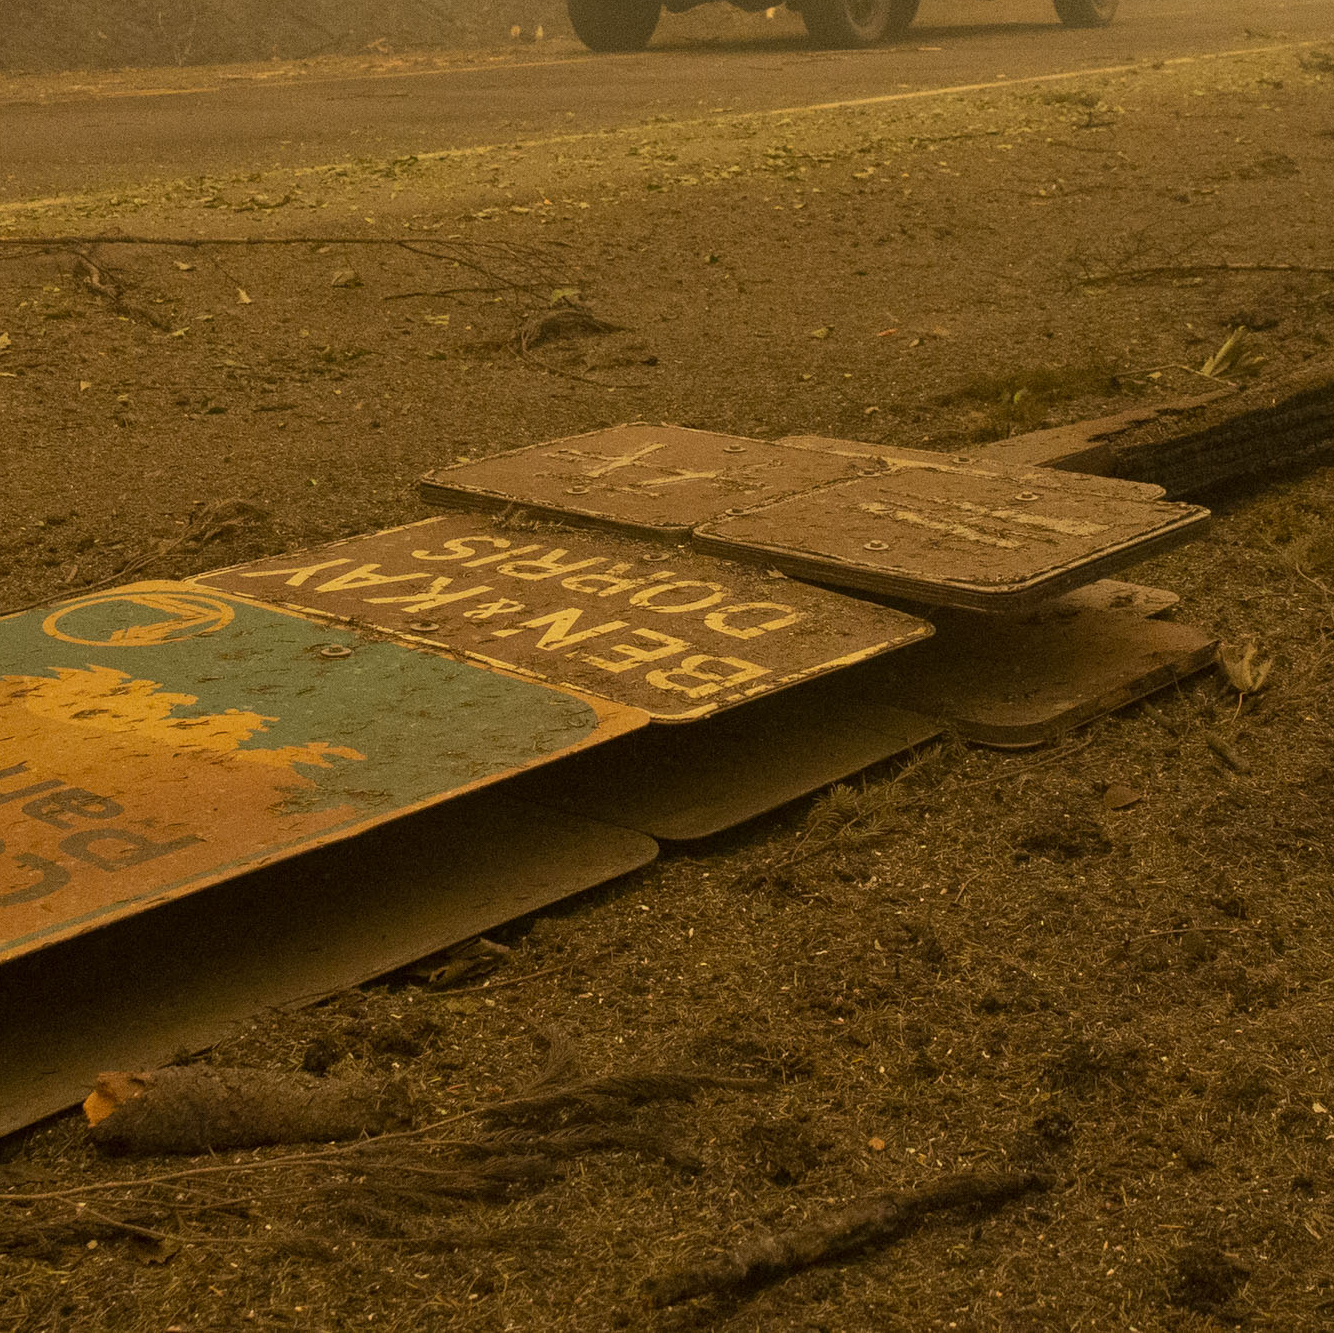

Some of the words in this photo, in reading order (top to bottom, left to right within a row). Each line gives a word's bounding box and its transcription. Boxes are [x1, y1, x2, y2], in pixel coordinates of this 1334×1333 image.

[239, 558, 494, 614] KAY
[411, 536, 799, 640] DORRIS
[463, 597, 526, 619] &
[491, 607, 773, 699] BEN
